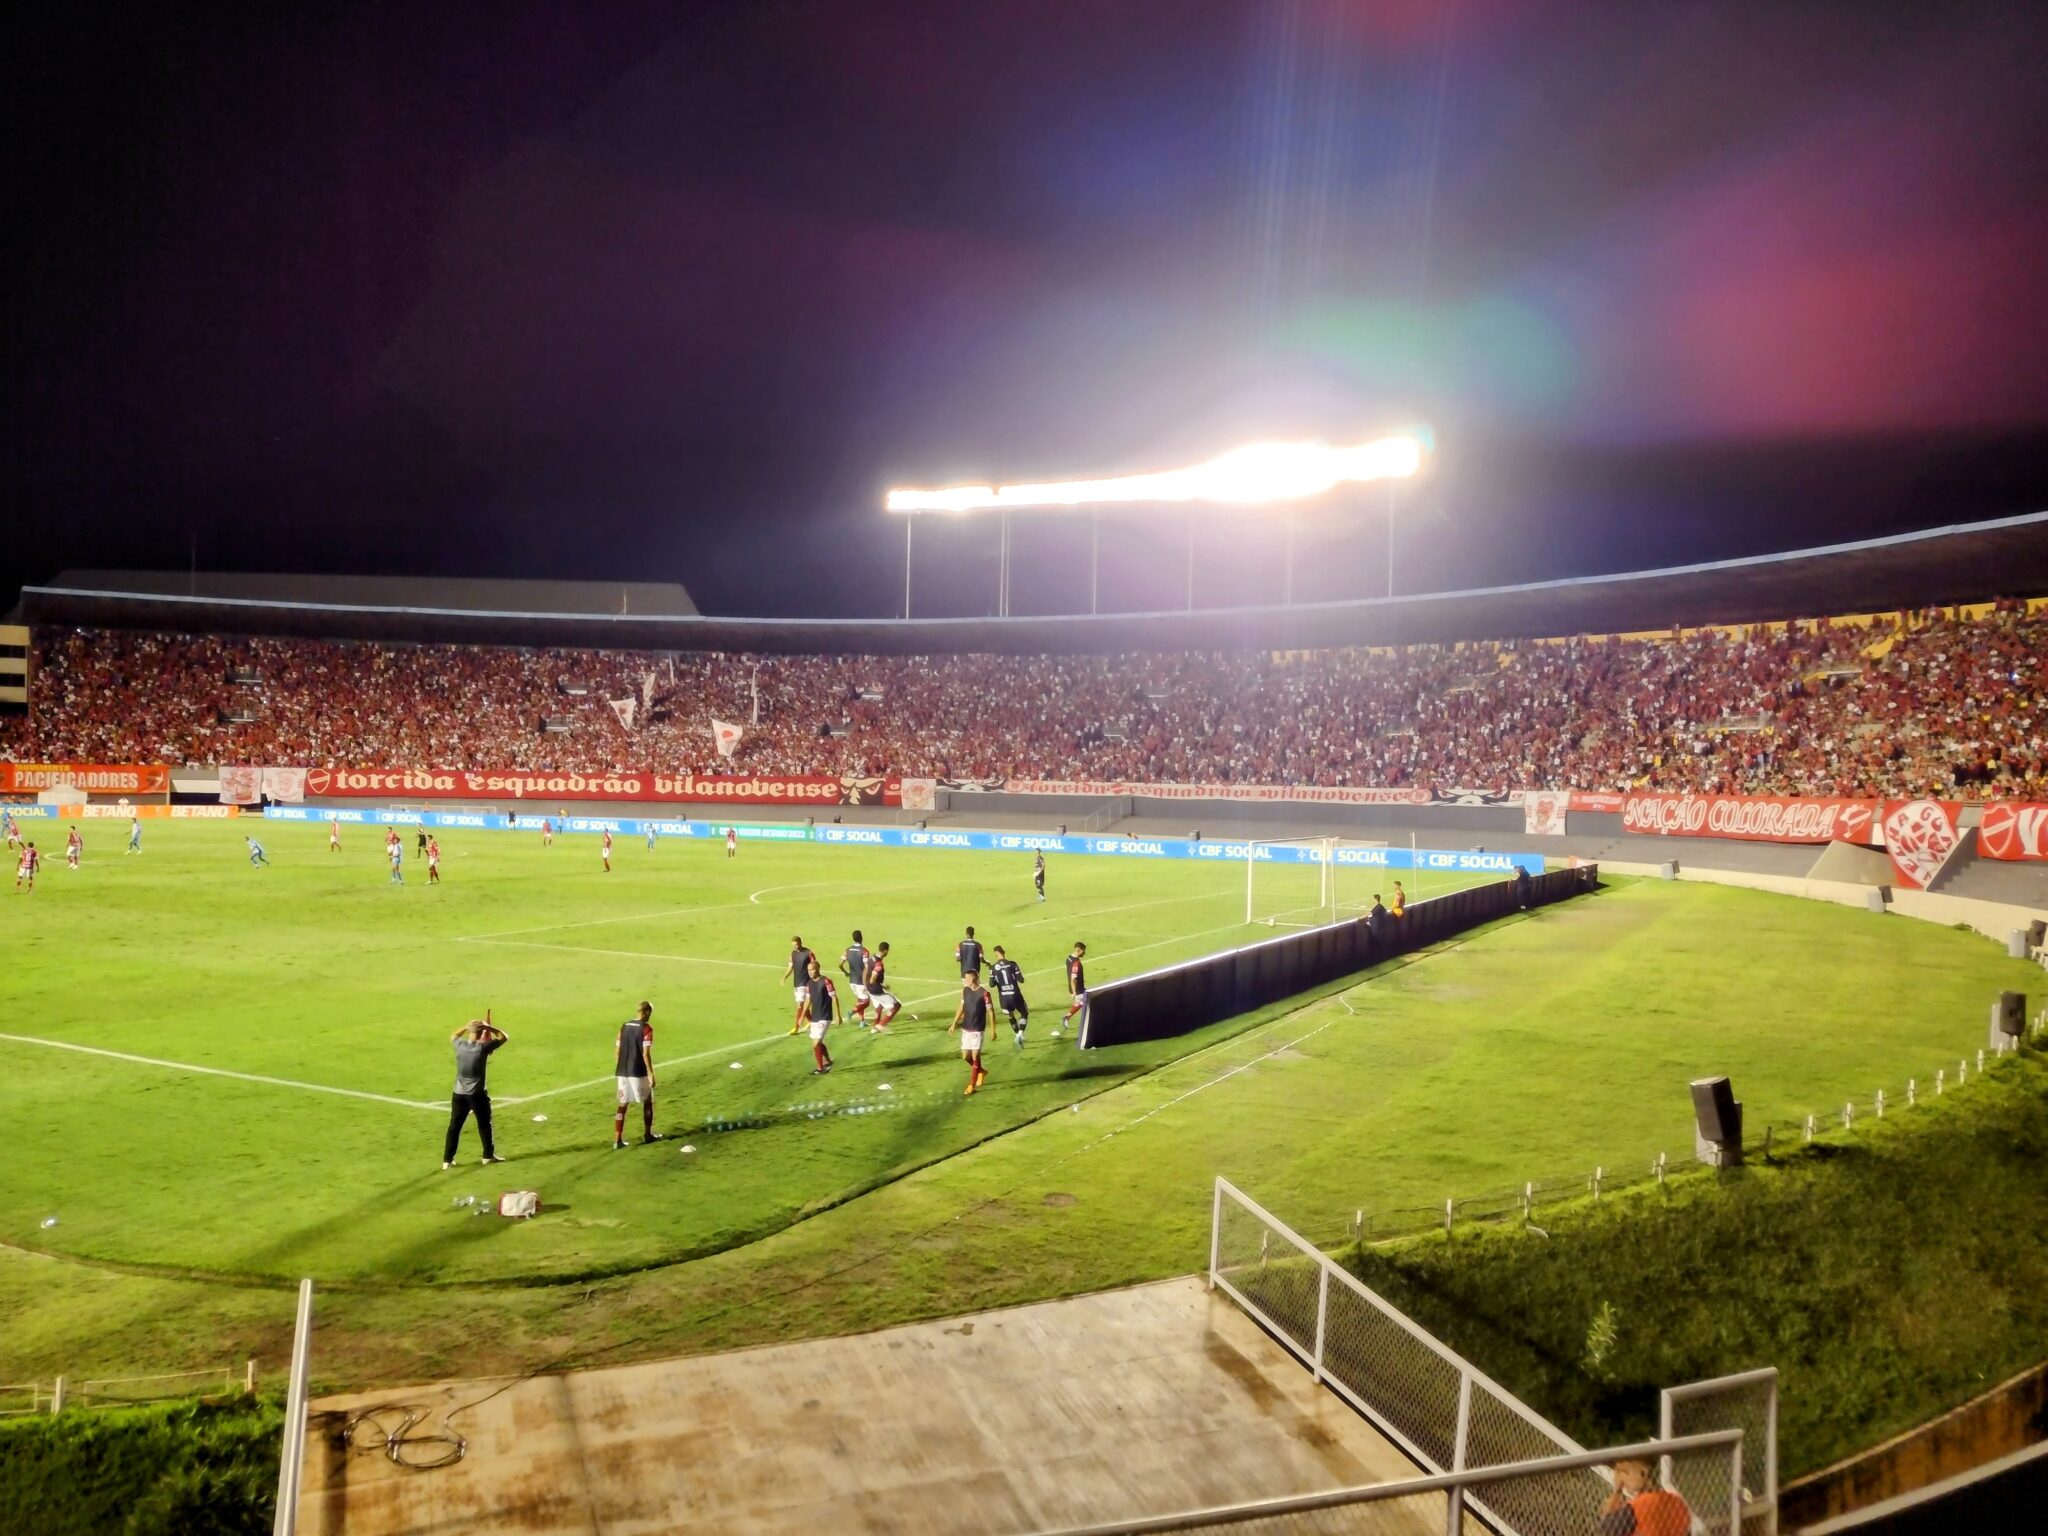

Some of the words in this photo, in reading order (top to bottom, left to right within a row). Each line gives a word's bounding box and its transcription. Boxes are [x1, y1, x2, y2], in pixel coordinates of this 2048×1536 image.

[15, 771, 138, 788] PACIFICADORES
[335, 769, 456, 790] torcida
[654, 775, 838, 798] vilanovense
[9, 806, 48, 817] SOCIAL
[82, 805, 137, 817] BETANO
[170, 805, 229, 818] BETANO
[1708, 800, 1841, 838] COLORADA
[661, 824, 694, 834] SOCIAL
[826, 830, 845, 840] CBF
[846, 831, 883, 842] SOCIAL
[910, 833, 930, 844] CBF
[931, 834, 971, 846] SOCIAL
[1000, 837, 1021, 847] CBF
[1023, 838, 1064, 849] SOCIAL
[1096, 841, 1119, 852] CBF
[1120, 842, 1165, 854] SOCIAL
[1199, 845, 1223, 857] CBF
[1337, 850, 1389, 863] SOCIAL
[1429, 854, 1457, 867] CBF
[1459, 855, 1514, 869] SOCIAL
